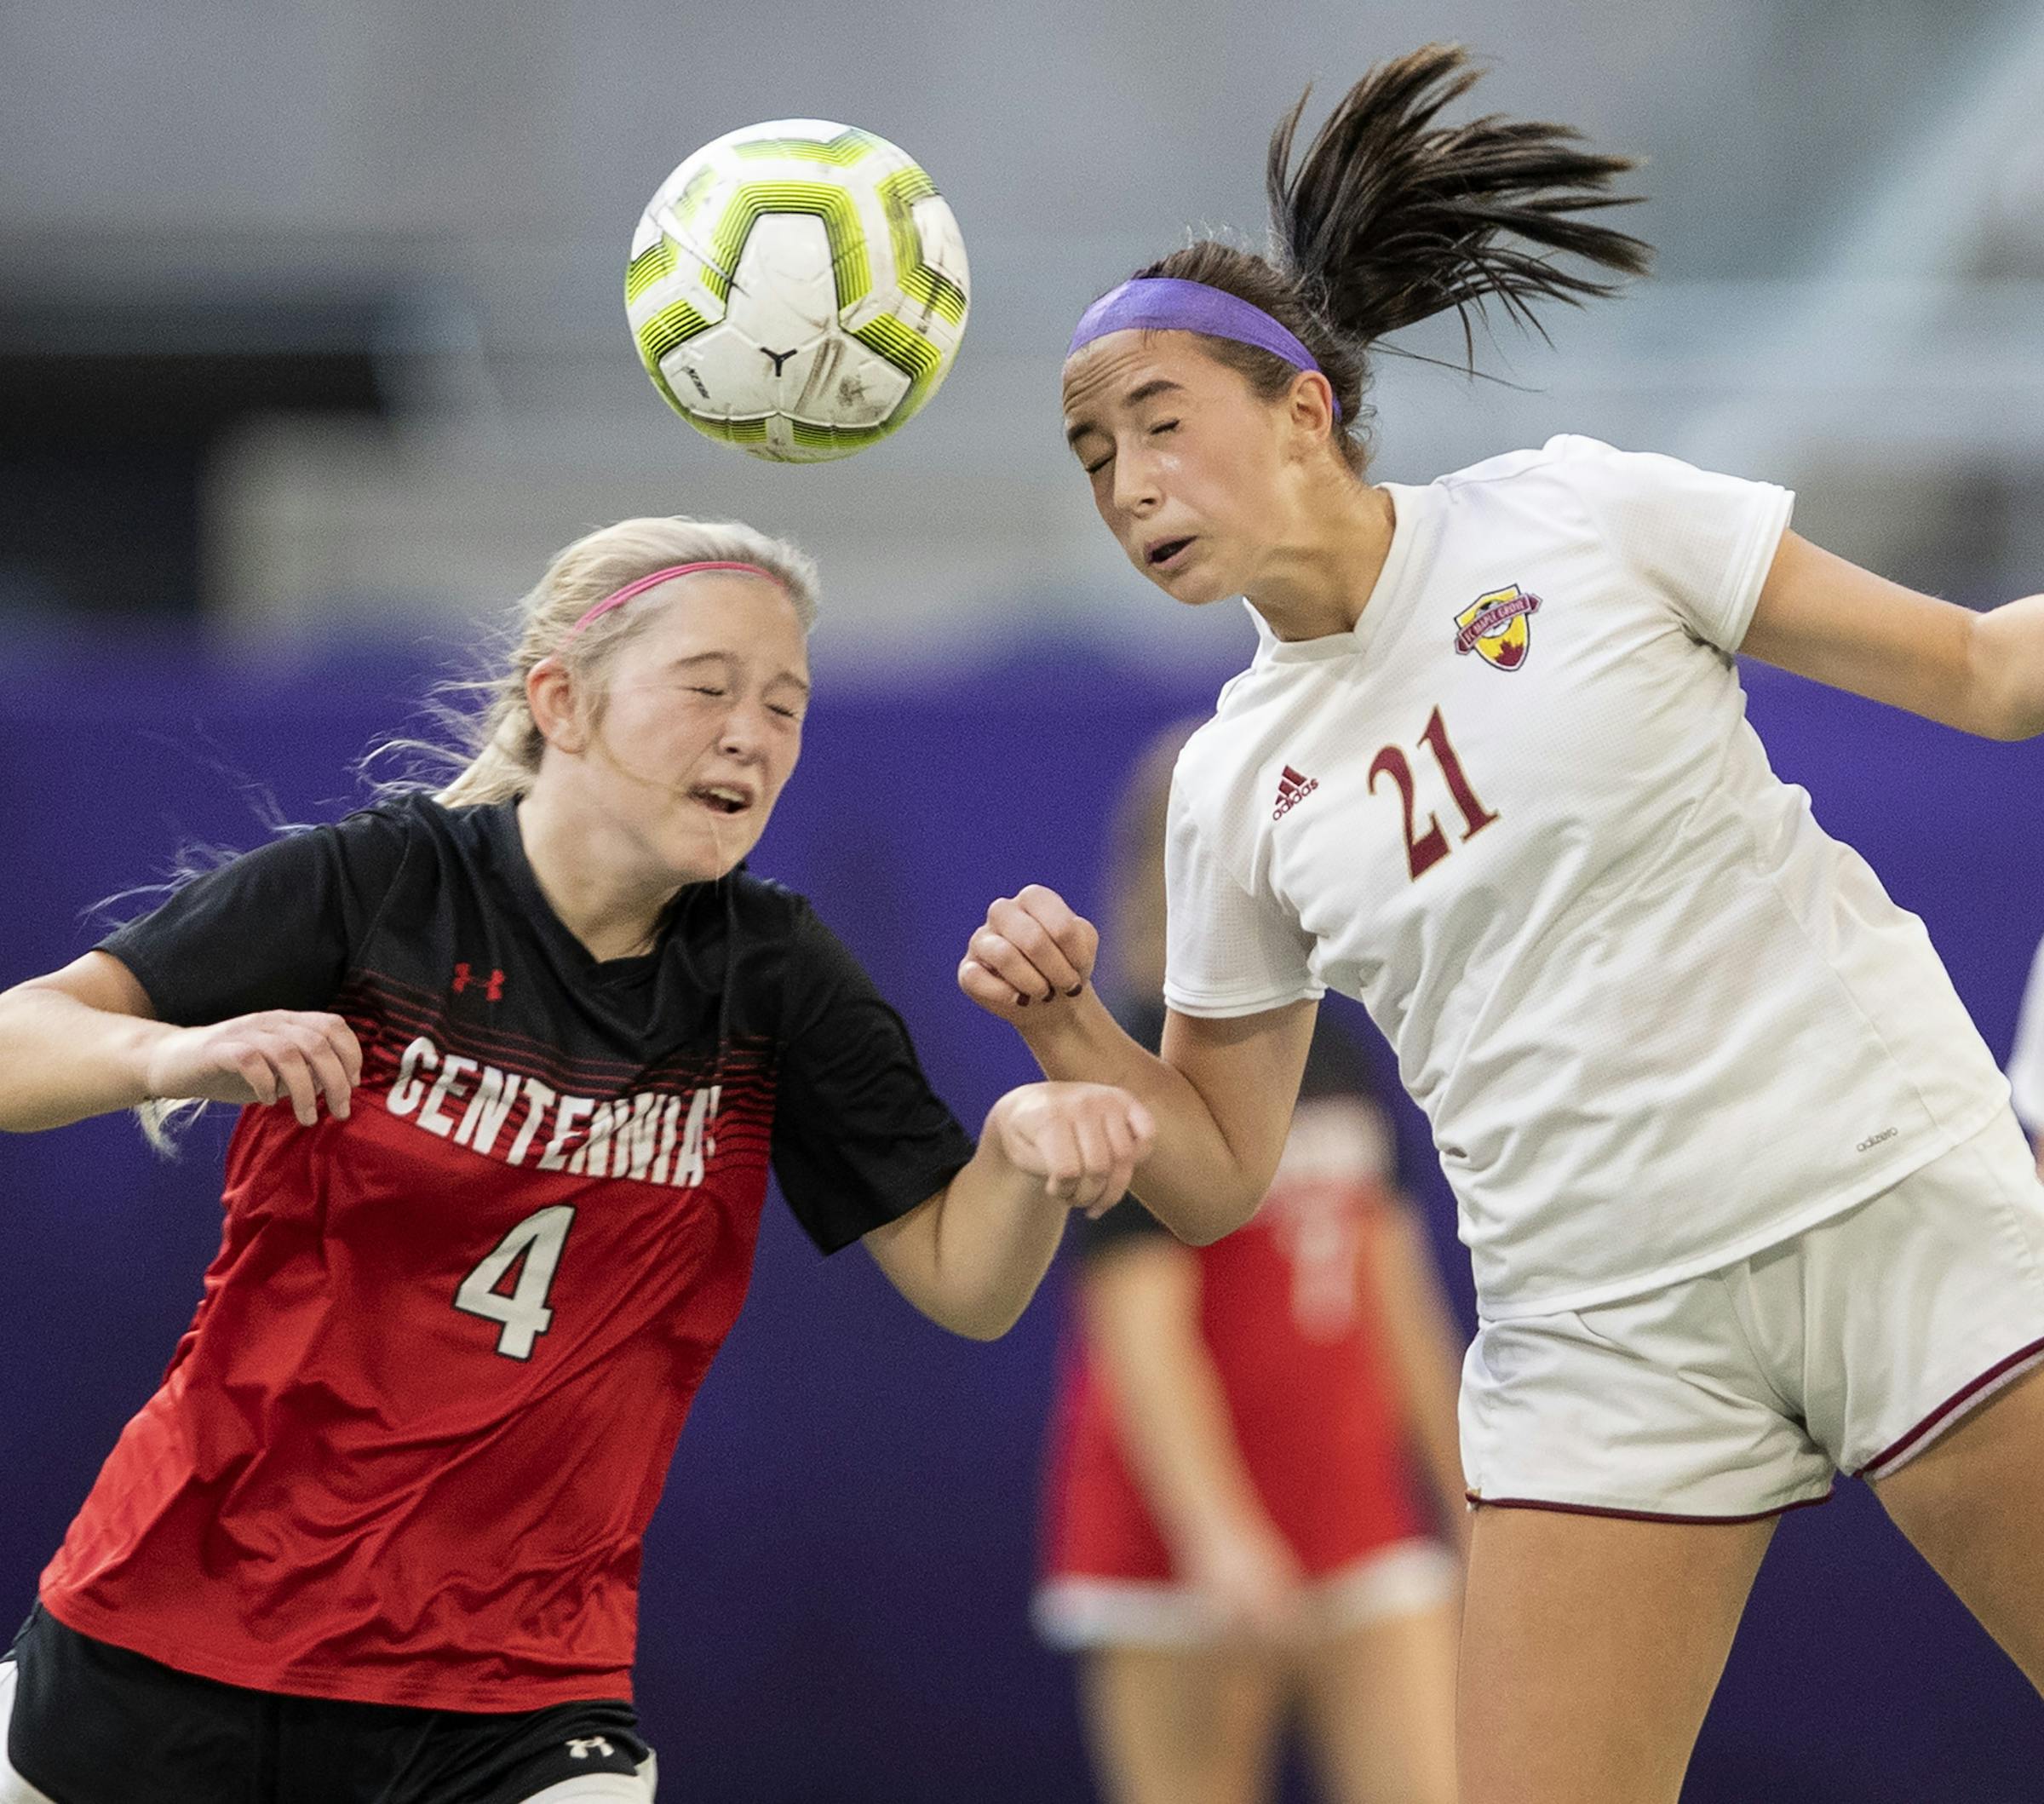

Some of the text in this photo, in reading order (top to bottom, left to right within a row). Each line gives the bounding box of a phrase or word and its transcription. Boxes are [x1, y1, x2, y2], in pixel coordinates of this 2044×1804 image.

[1272, 778, 1319, 821] adidas
[1367, 703, 1501, 882] 21
[1857, 1126, 1898, 1152] adizero
[451, 1204, 577, 1363] 4
